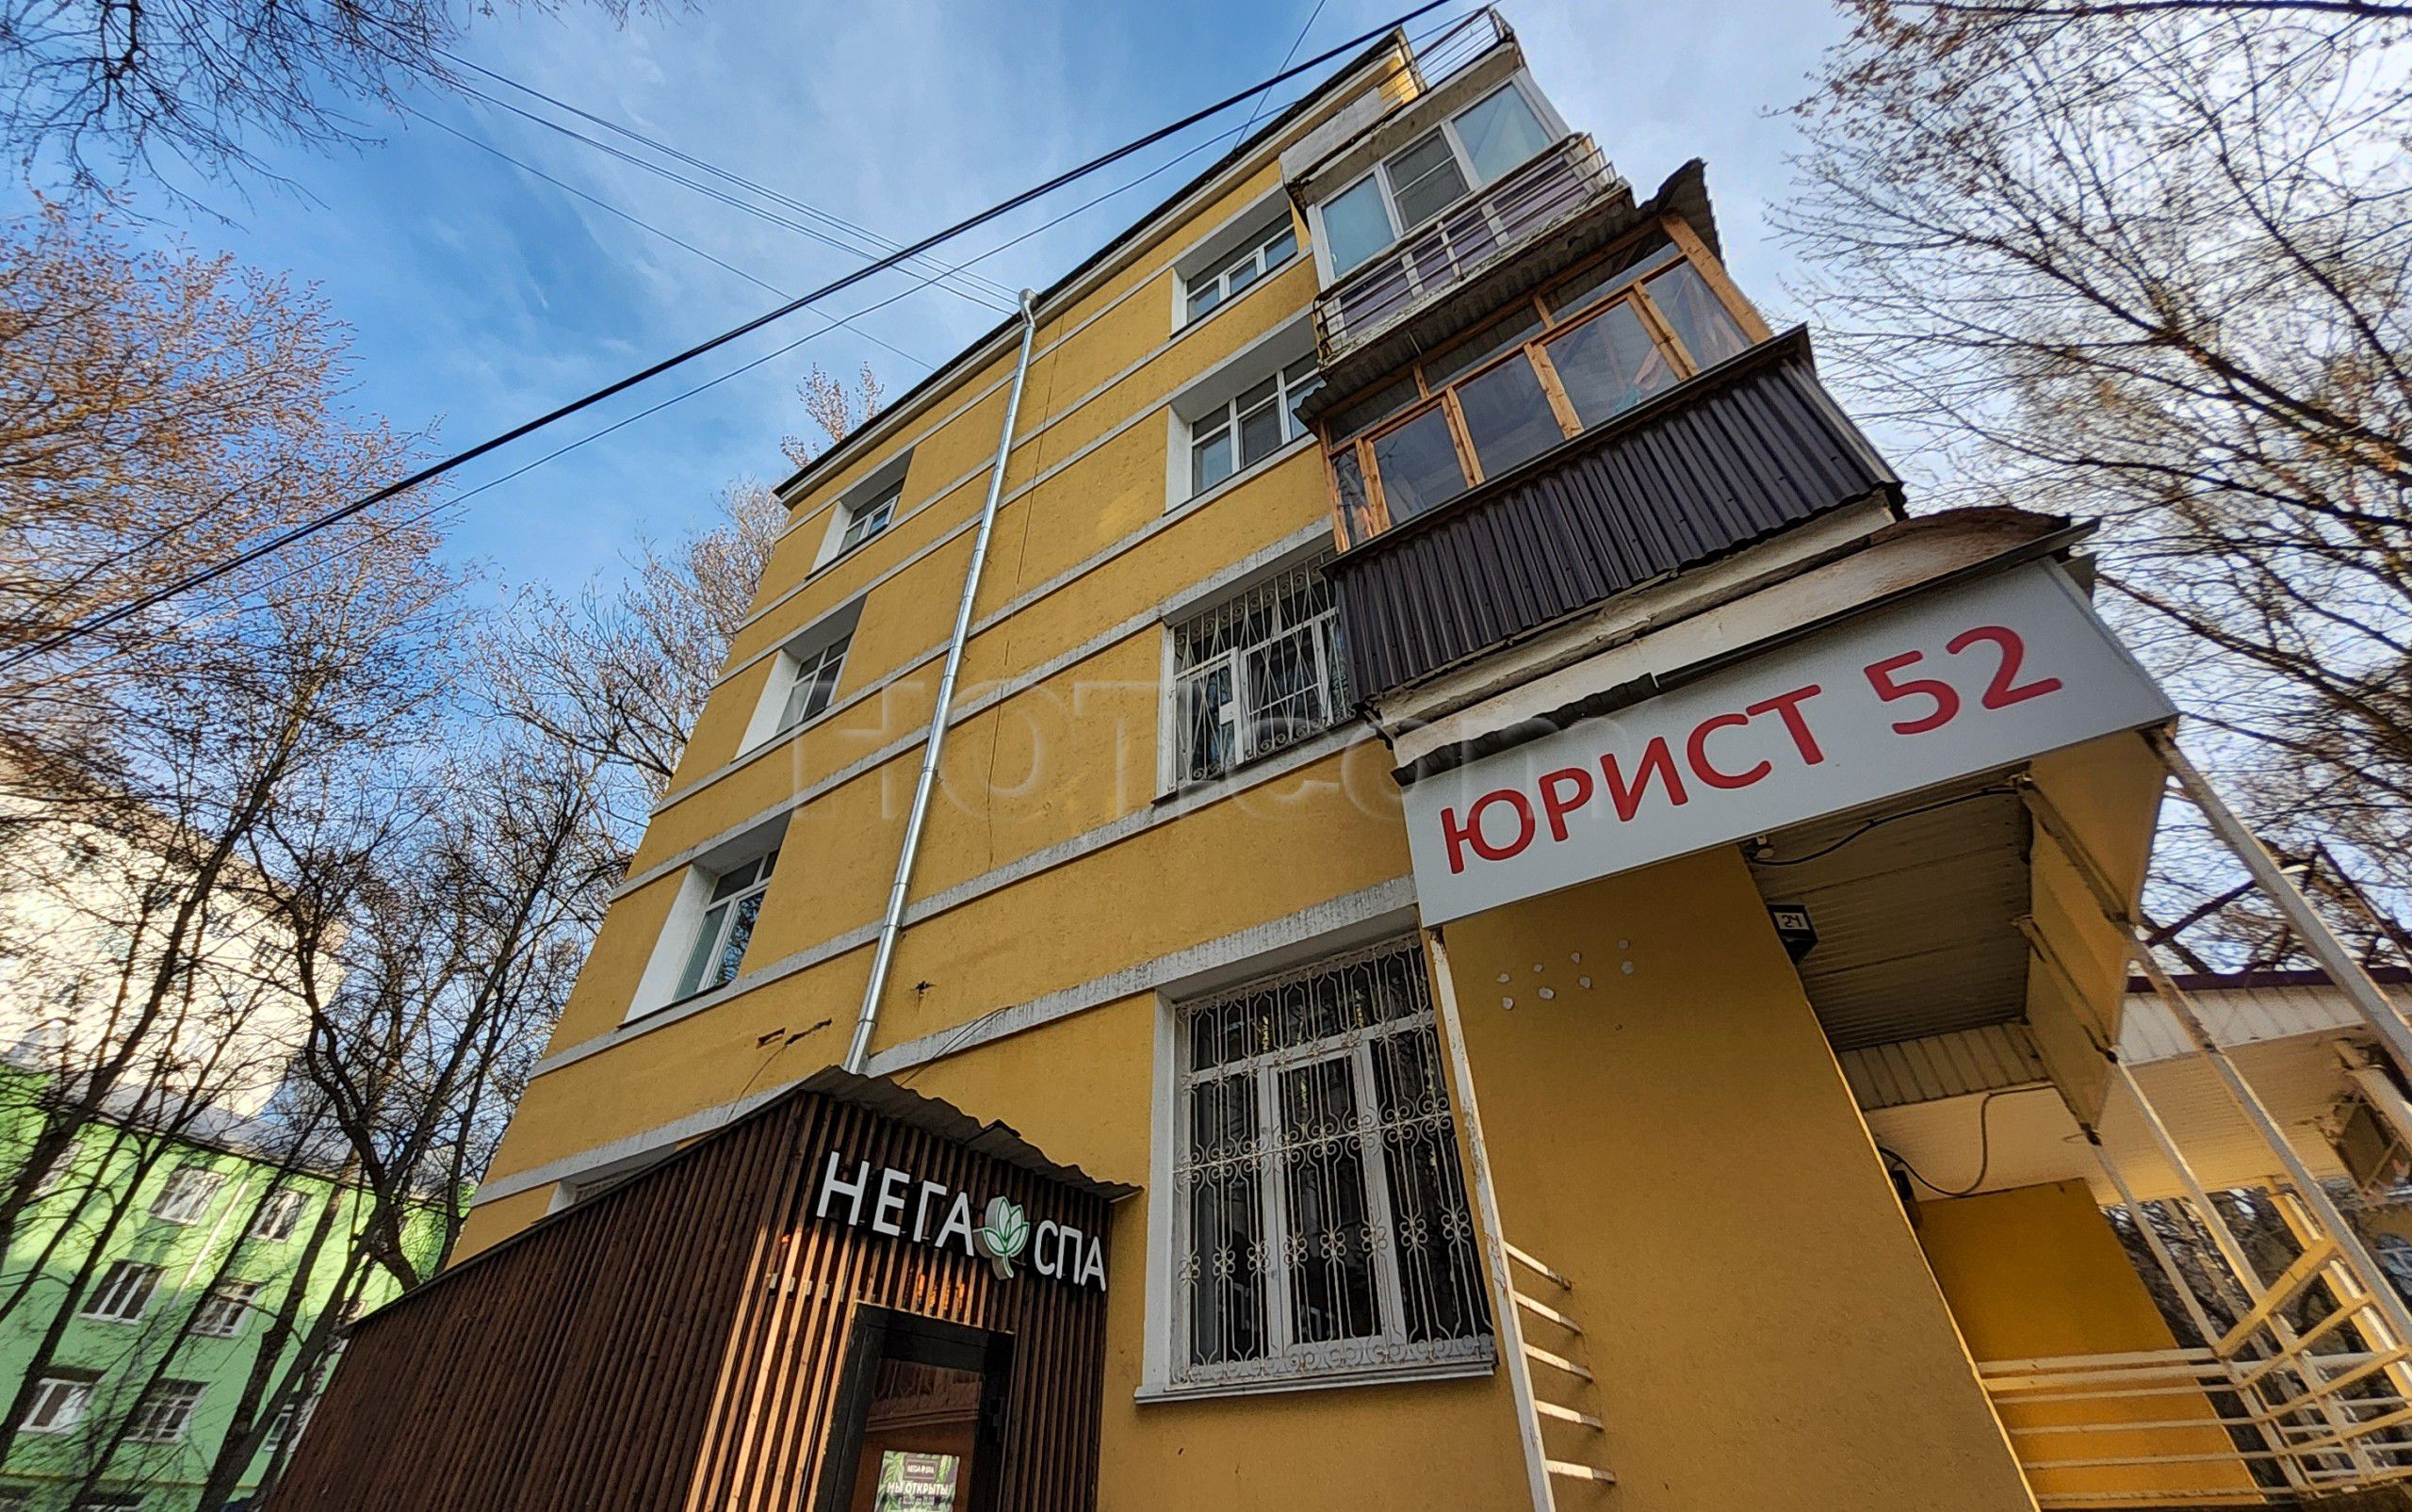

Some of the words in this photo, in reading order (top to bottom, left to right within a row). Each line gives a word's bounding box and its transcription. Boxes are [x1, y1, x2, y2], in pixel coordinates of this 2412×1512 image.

[1441, 684, 1826, 875] ЮРИСТ
[1863, 625, 2064, 736] 52
[816, 1151, 975, 1258] НЕГА
[1034, 1219, 1107, 1293] СПА
[887, 1482, 904, 1494] МЫ
[904, 1482, 949, 1496] ОТКРЫТЫ
